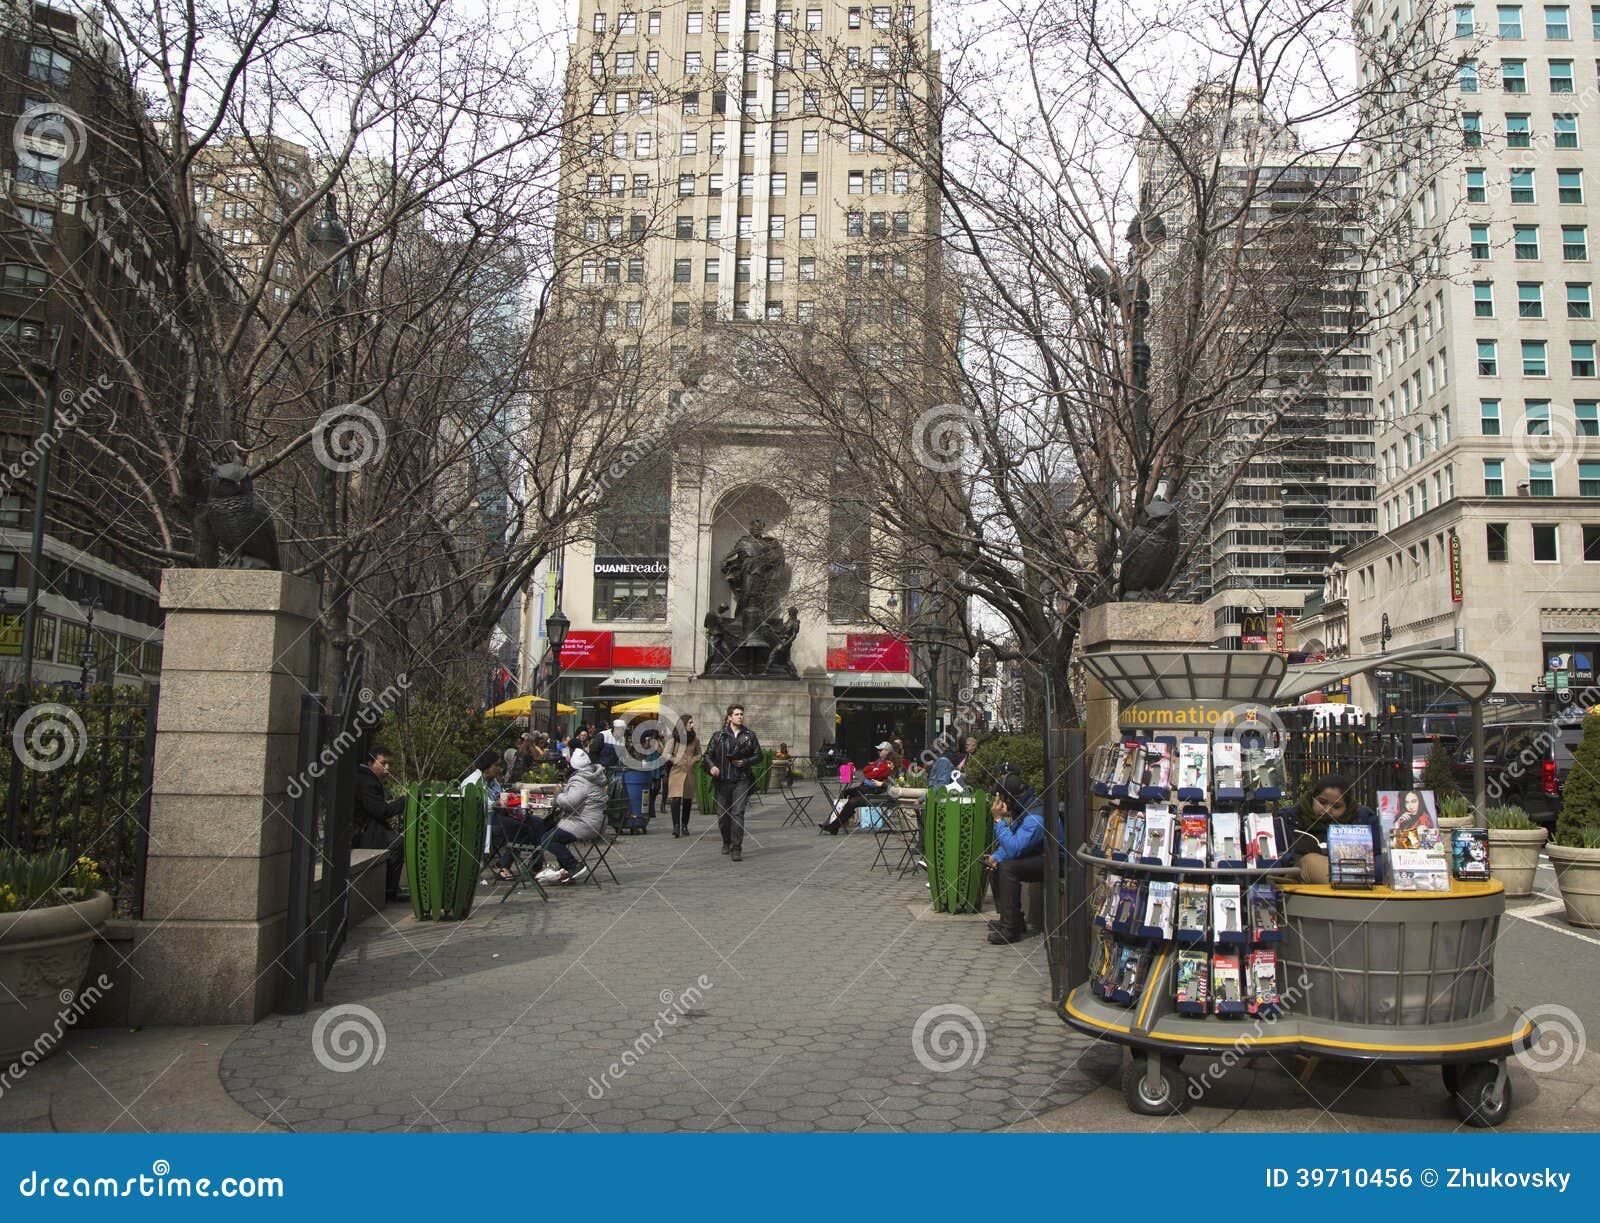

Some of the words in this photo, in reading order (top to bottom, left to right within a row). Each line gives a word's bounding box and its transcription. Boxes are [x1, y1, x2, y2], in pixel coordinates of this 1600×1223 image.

[1453, 536, 1461, 596] COURTYARD
[614, 677, 640, 685] wafels
[641, 677, 647, 685] &
